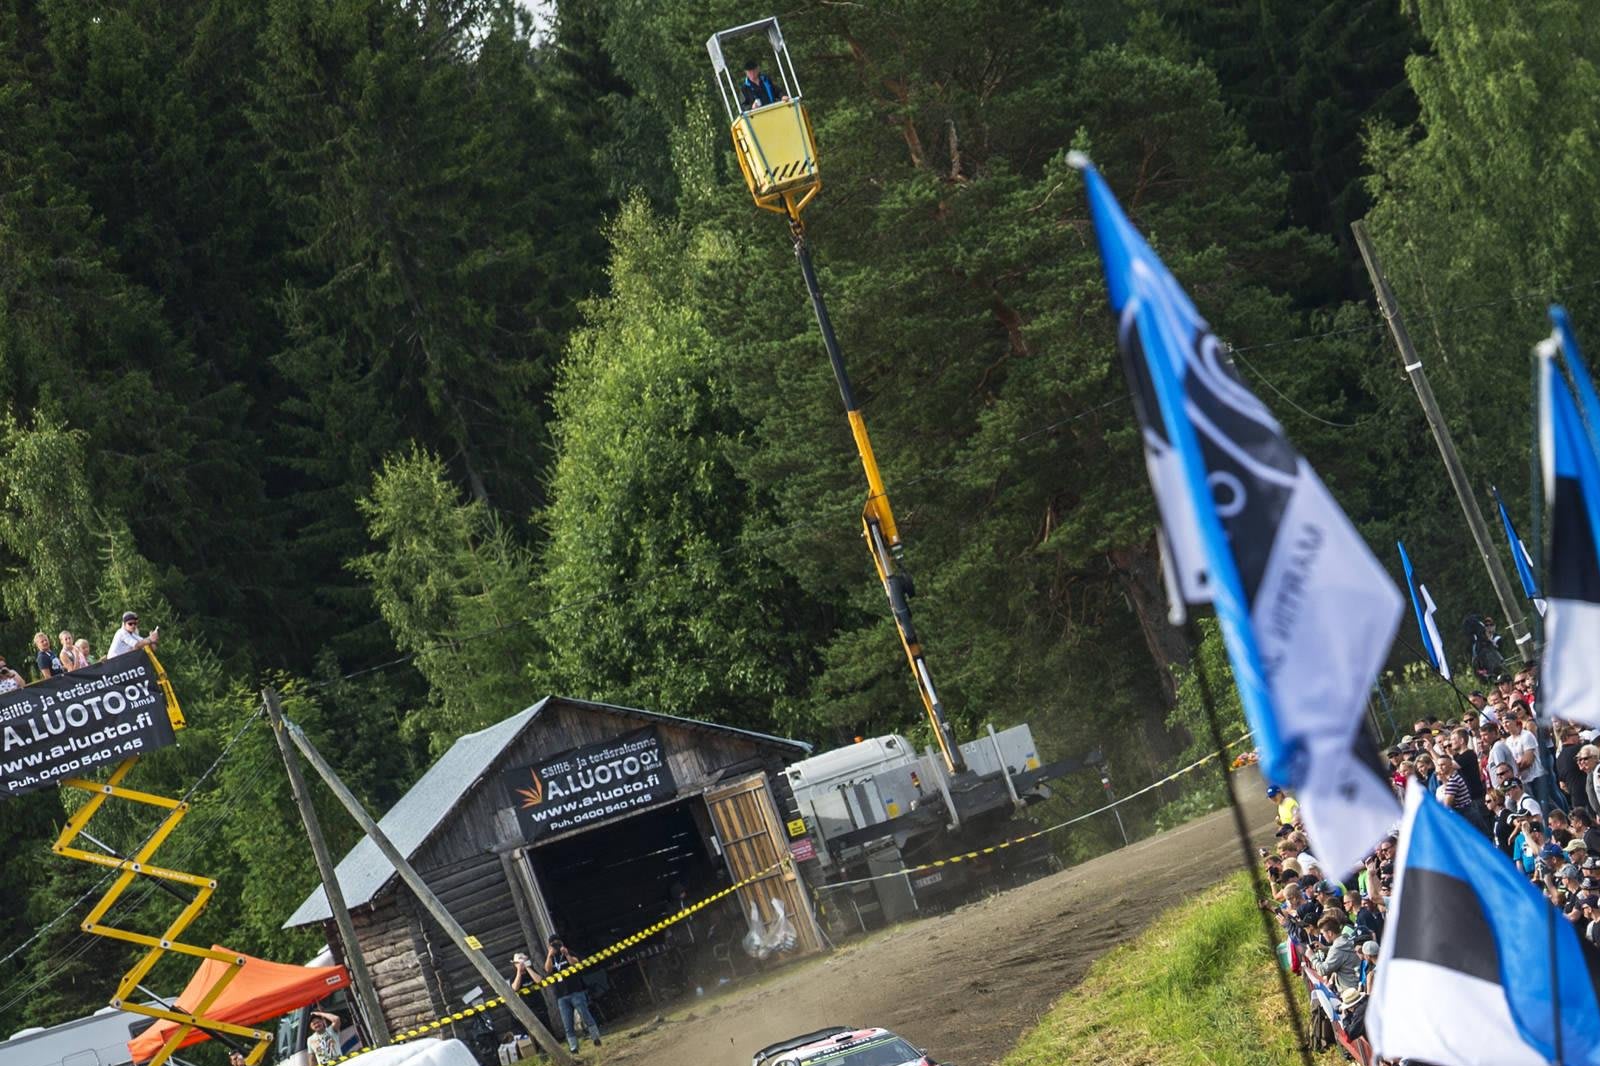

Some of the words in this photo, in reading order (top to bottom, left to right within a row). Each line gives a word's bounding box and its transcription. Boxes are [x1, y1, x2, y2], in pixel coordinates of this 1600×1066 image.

[40, 695, 55, 711] ja
[56, 666, 146, 701] teräsrakenne
[3, 690, 126, 752] A.LUOTO
[125, 680, 150, 701] OY
[0, 712, 153, 777] ww.a-luoto.fi
[8, 775, 39, 791] Puh.
[40, 759, 80, 780] 0400
[81, 749, 111, 765] 540
[114, 738, 143, 754] 145
[576, 757, 588, 770] ja
[532, 774, 660, 823] www.a-luoto.fi
[547, 756, 640, 800] A.LUOTO
[550, 819, 573, 830] Puh.
[574, 808, 604, 823] 0400
[605, 801, 628, 814] 540
[629, 793, 652, 806] 145
